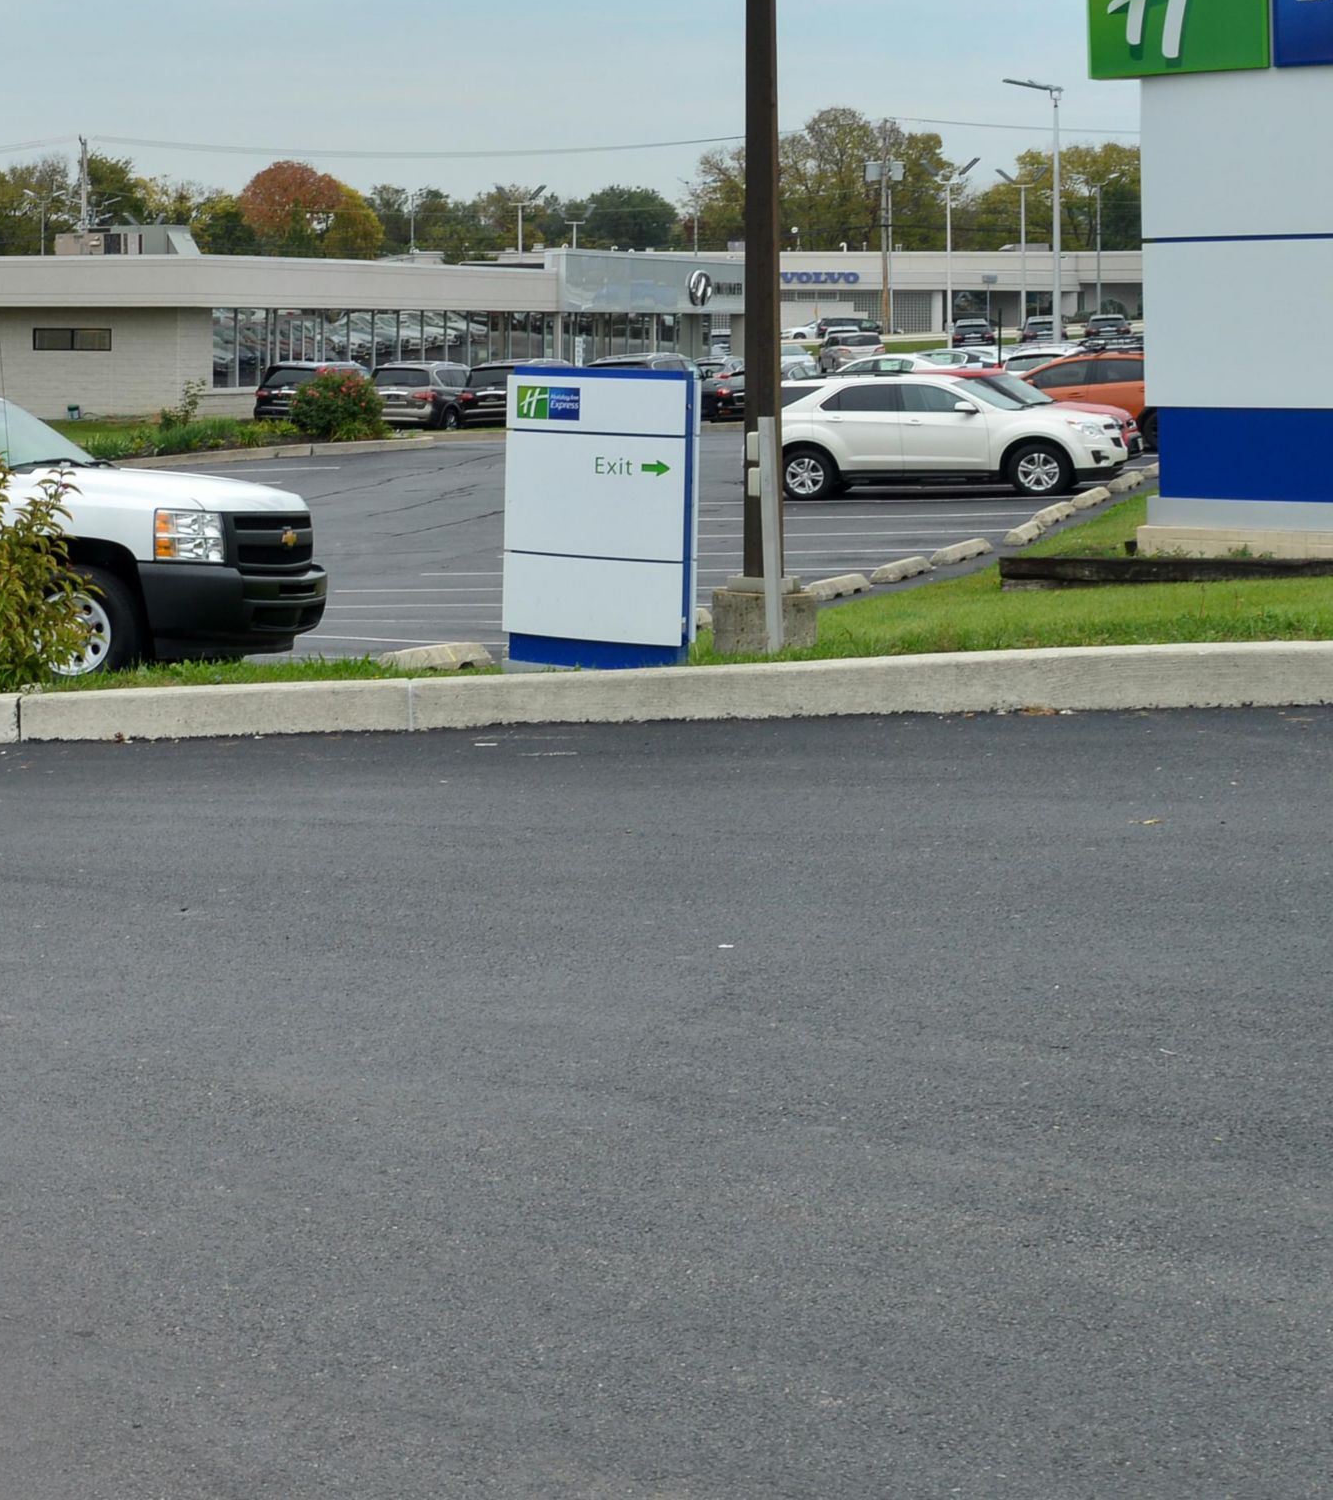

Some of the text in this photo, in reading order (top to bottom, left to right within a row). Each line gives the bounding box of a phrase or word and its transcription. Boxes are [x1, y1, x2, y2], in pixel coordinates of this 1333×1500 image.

[780, 272, 860, 284] VOLVO
[550, 400, 579, 410] Express
[595, 457, 633, 476] Exit
